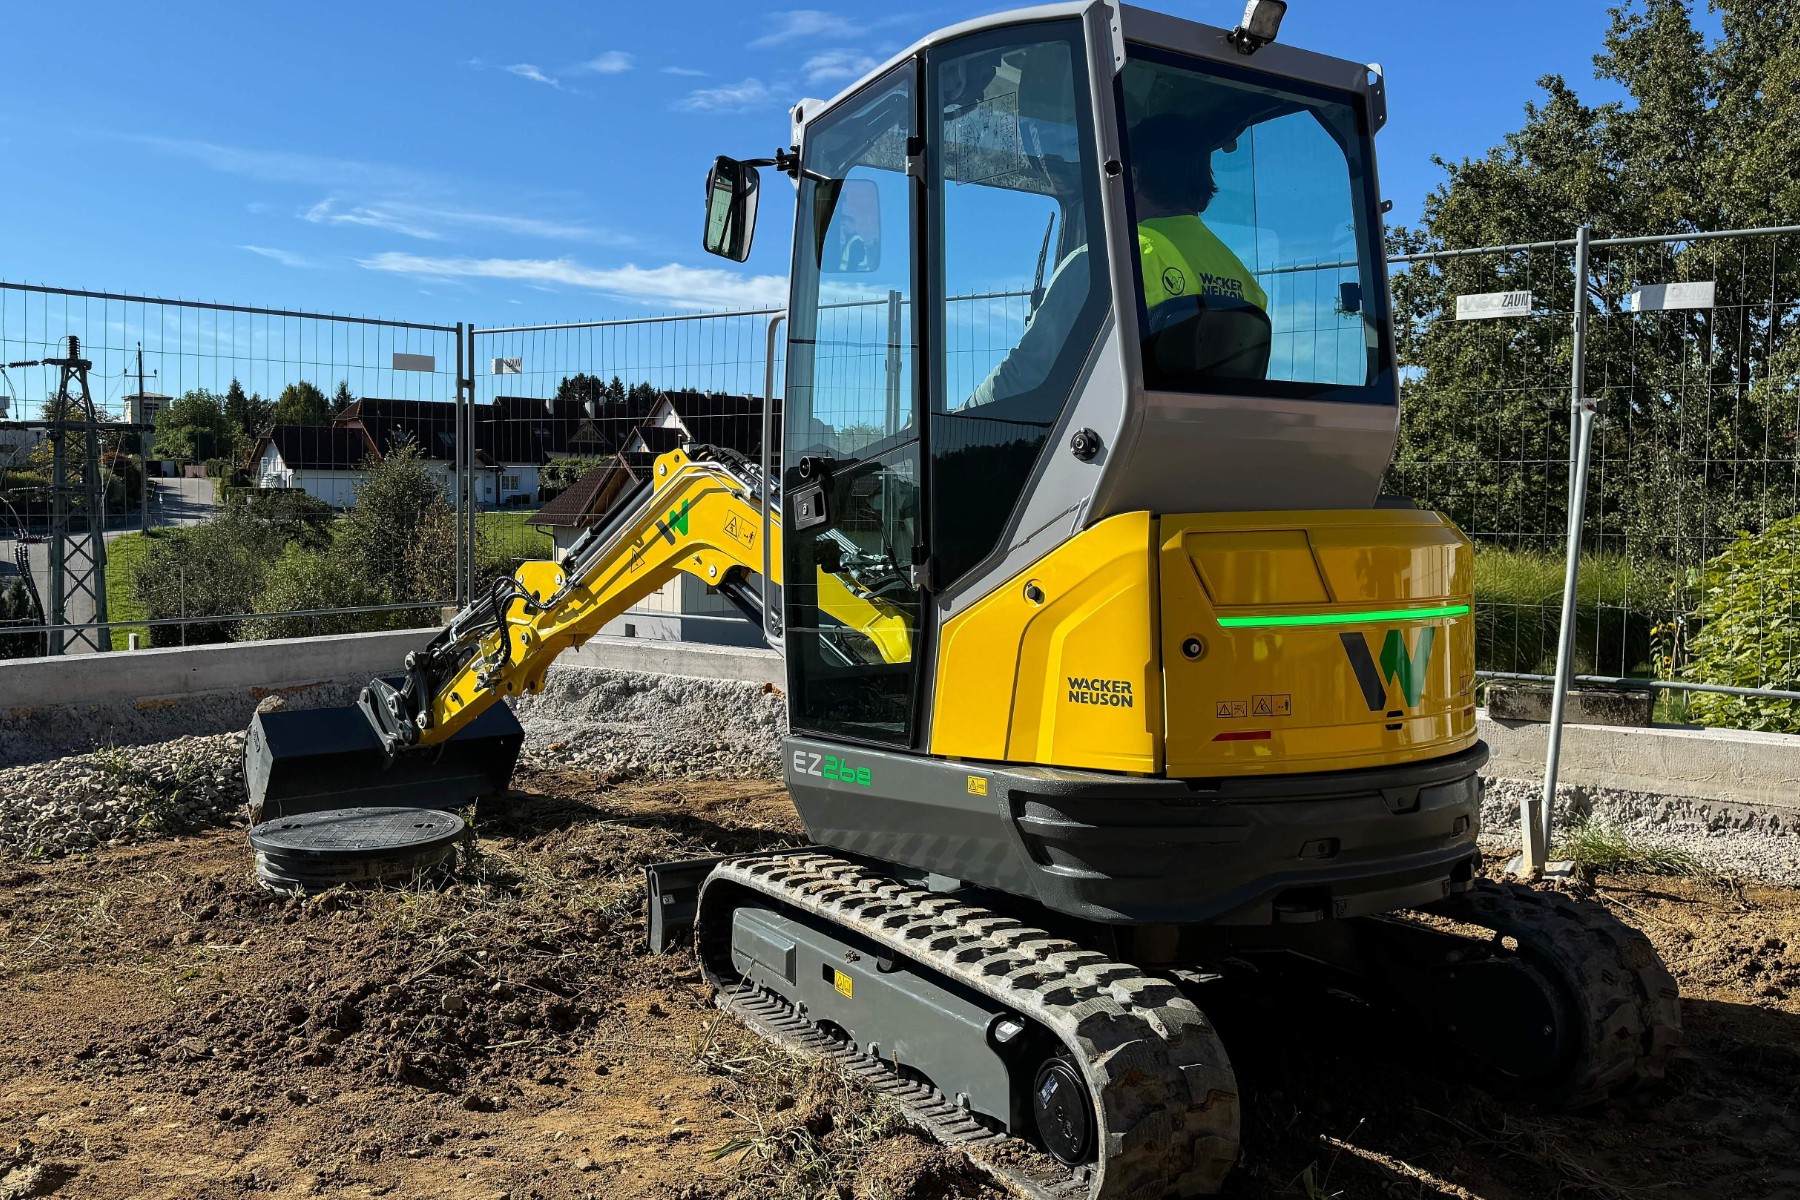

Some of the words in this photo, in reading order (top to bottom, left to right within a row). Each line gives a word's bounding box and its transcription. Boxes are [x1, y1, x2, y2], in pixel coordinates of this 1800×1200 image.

[1199, 272, 1243, 292] WACKER
[1501, 293, 1529, 308] ZAUN
[1067, 676, 1133, 694] WACKER
[1069, 691, 1133, 708] NEUSON
[793, 750, 872, 786] EZ26e
